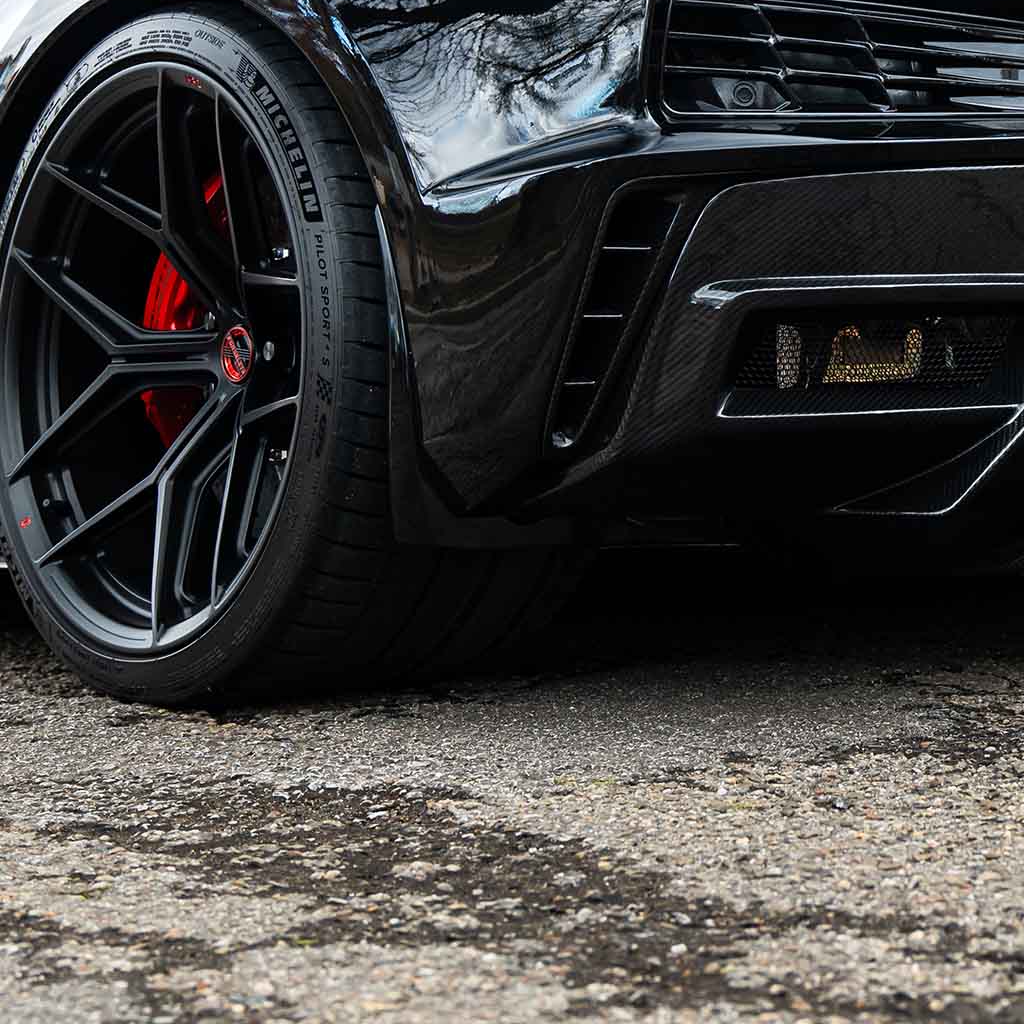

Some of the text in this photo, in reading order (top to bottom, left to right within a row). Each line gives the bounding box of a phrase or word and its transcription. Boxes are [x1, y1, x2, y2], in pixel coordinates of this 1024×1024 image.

[255, 85, 319, 213] MICHELIN
[314, 234, 328, 280] PILOT
[320, 286, 331, 342] SPORT
